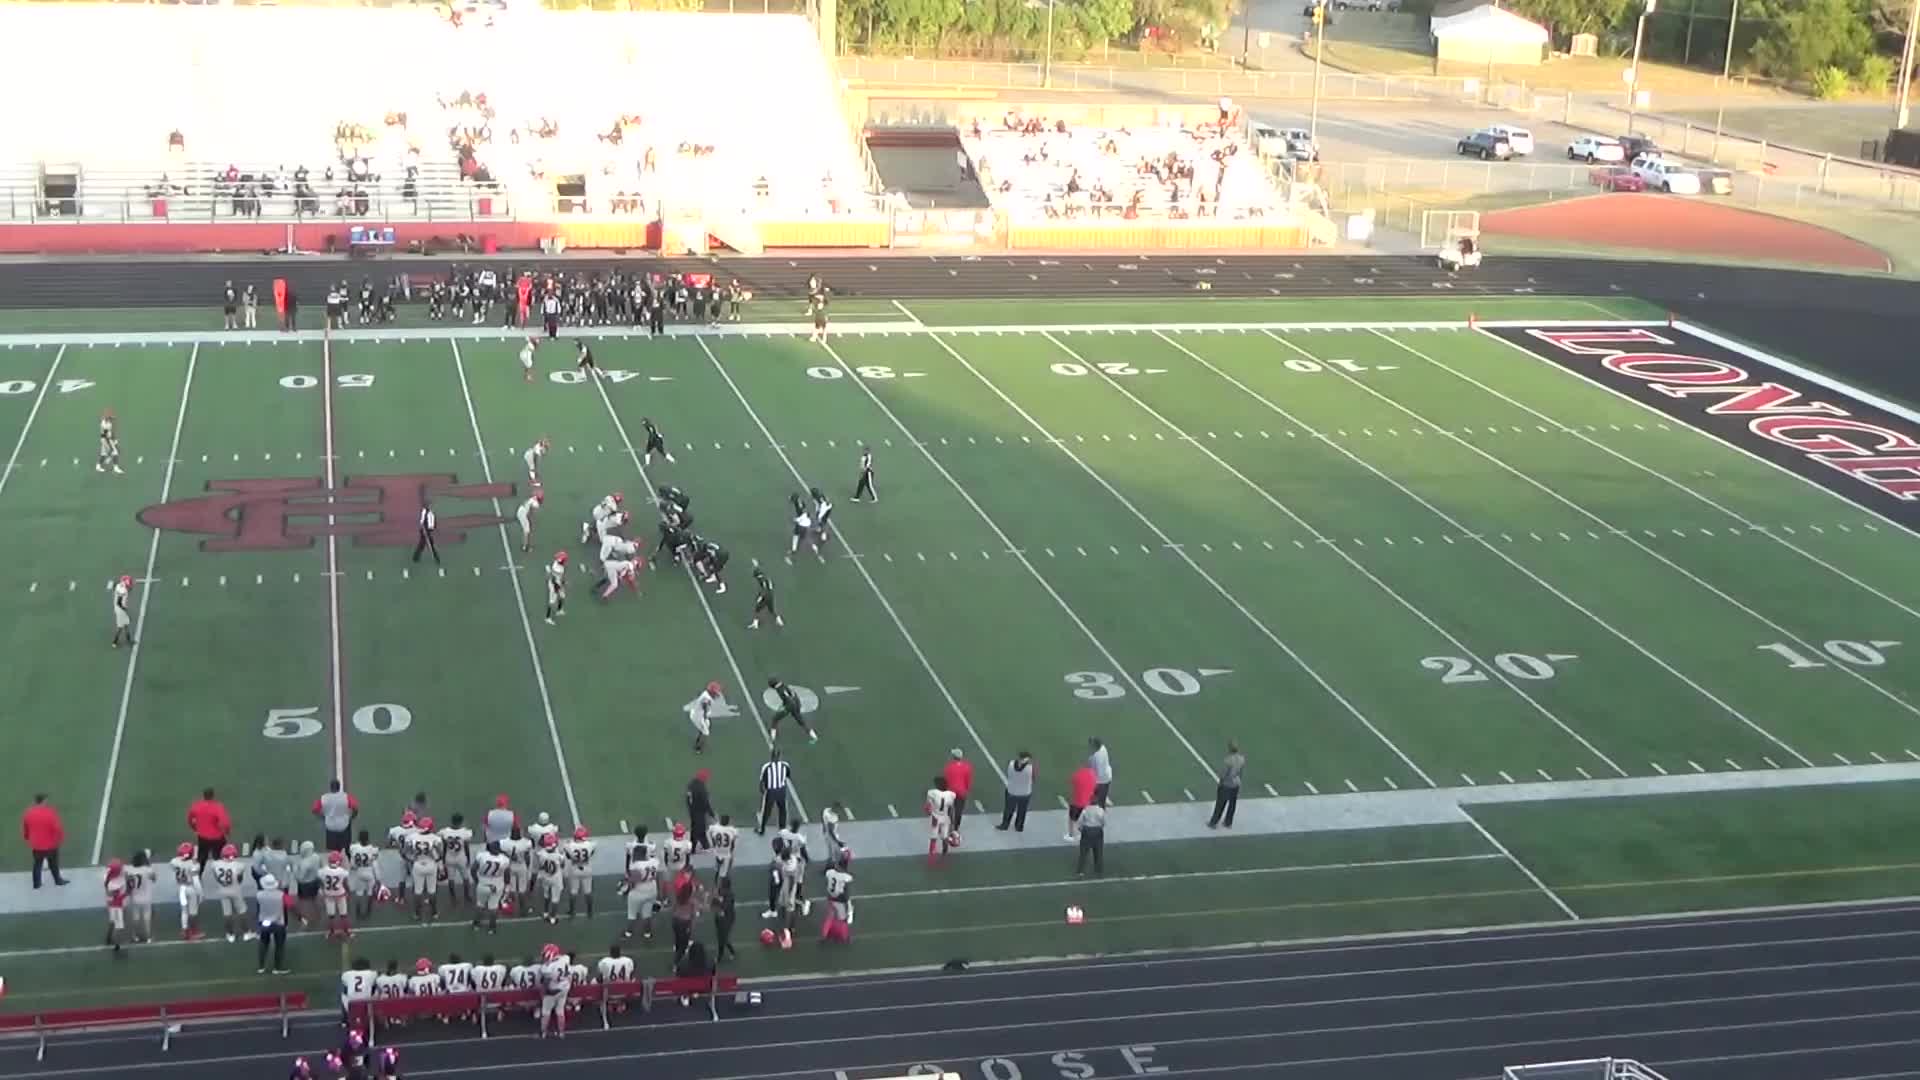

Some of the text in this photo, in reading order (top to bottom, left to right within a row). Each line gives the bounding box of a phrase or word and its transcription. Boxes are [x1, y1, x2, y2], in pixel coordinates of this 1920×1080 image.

[806, 365, 896, 379] 30
[1050, 362, 1140, 376] 20
[279, 373, 375, 388] 50
[1757, 640, 1885, 668] 10
[1420, 653, 1555, 684] 20
[1064, 668, 1200, 699] 30
[262, 703, 412, 738] 50
[574, 849, 588, 864] 33
[325, 875, 340, 891] 32
[354, 976, 363, 992] 2
[449, 969, 465, 985] 74
[481, 971, 497, 989] 69
[834, 1047, 1169, 1080] OSE
